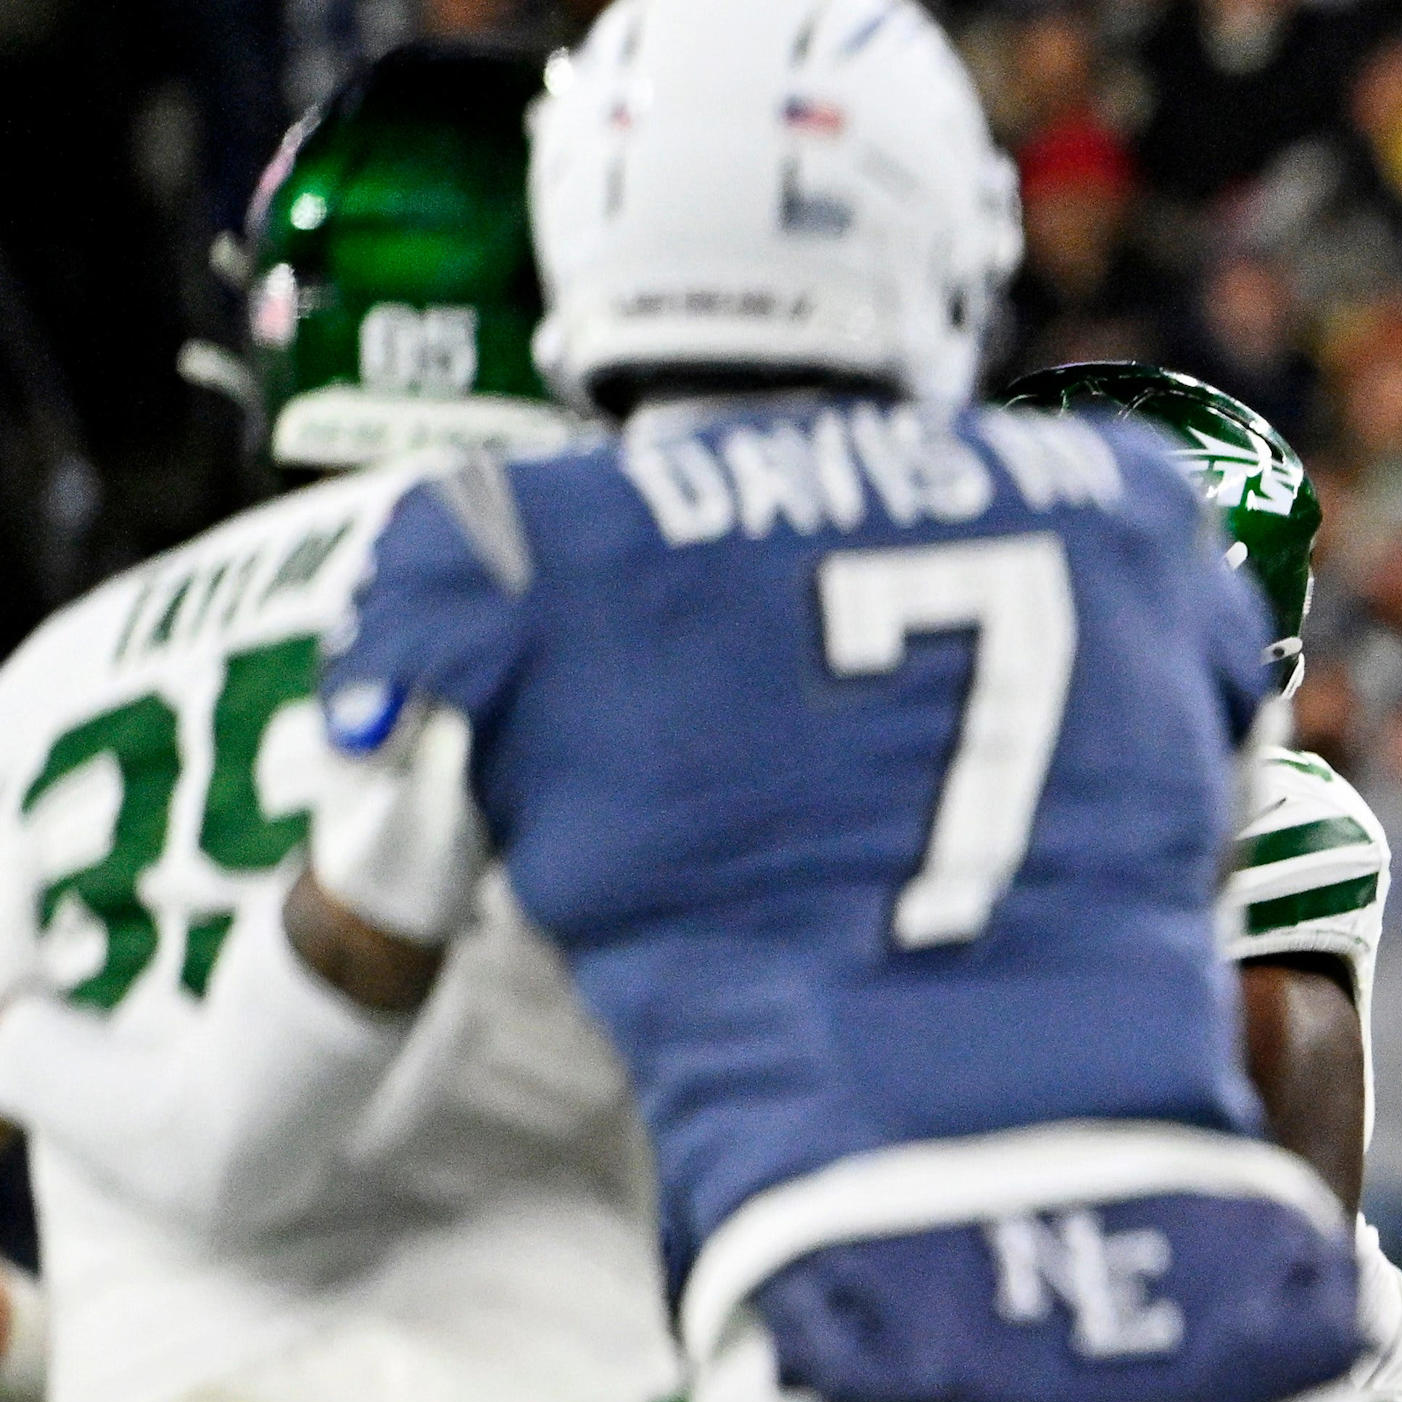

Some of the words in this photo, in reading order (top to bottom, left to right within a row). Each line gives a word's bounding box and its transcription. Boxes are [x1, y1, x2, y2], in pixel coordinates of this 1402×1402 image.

[620, 400, 992, 545] DAVIS
[817, 530, 1078, 954] 7
[986, 1206, 1186, 1358] NE
